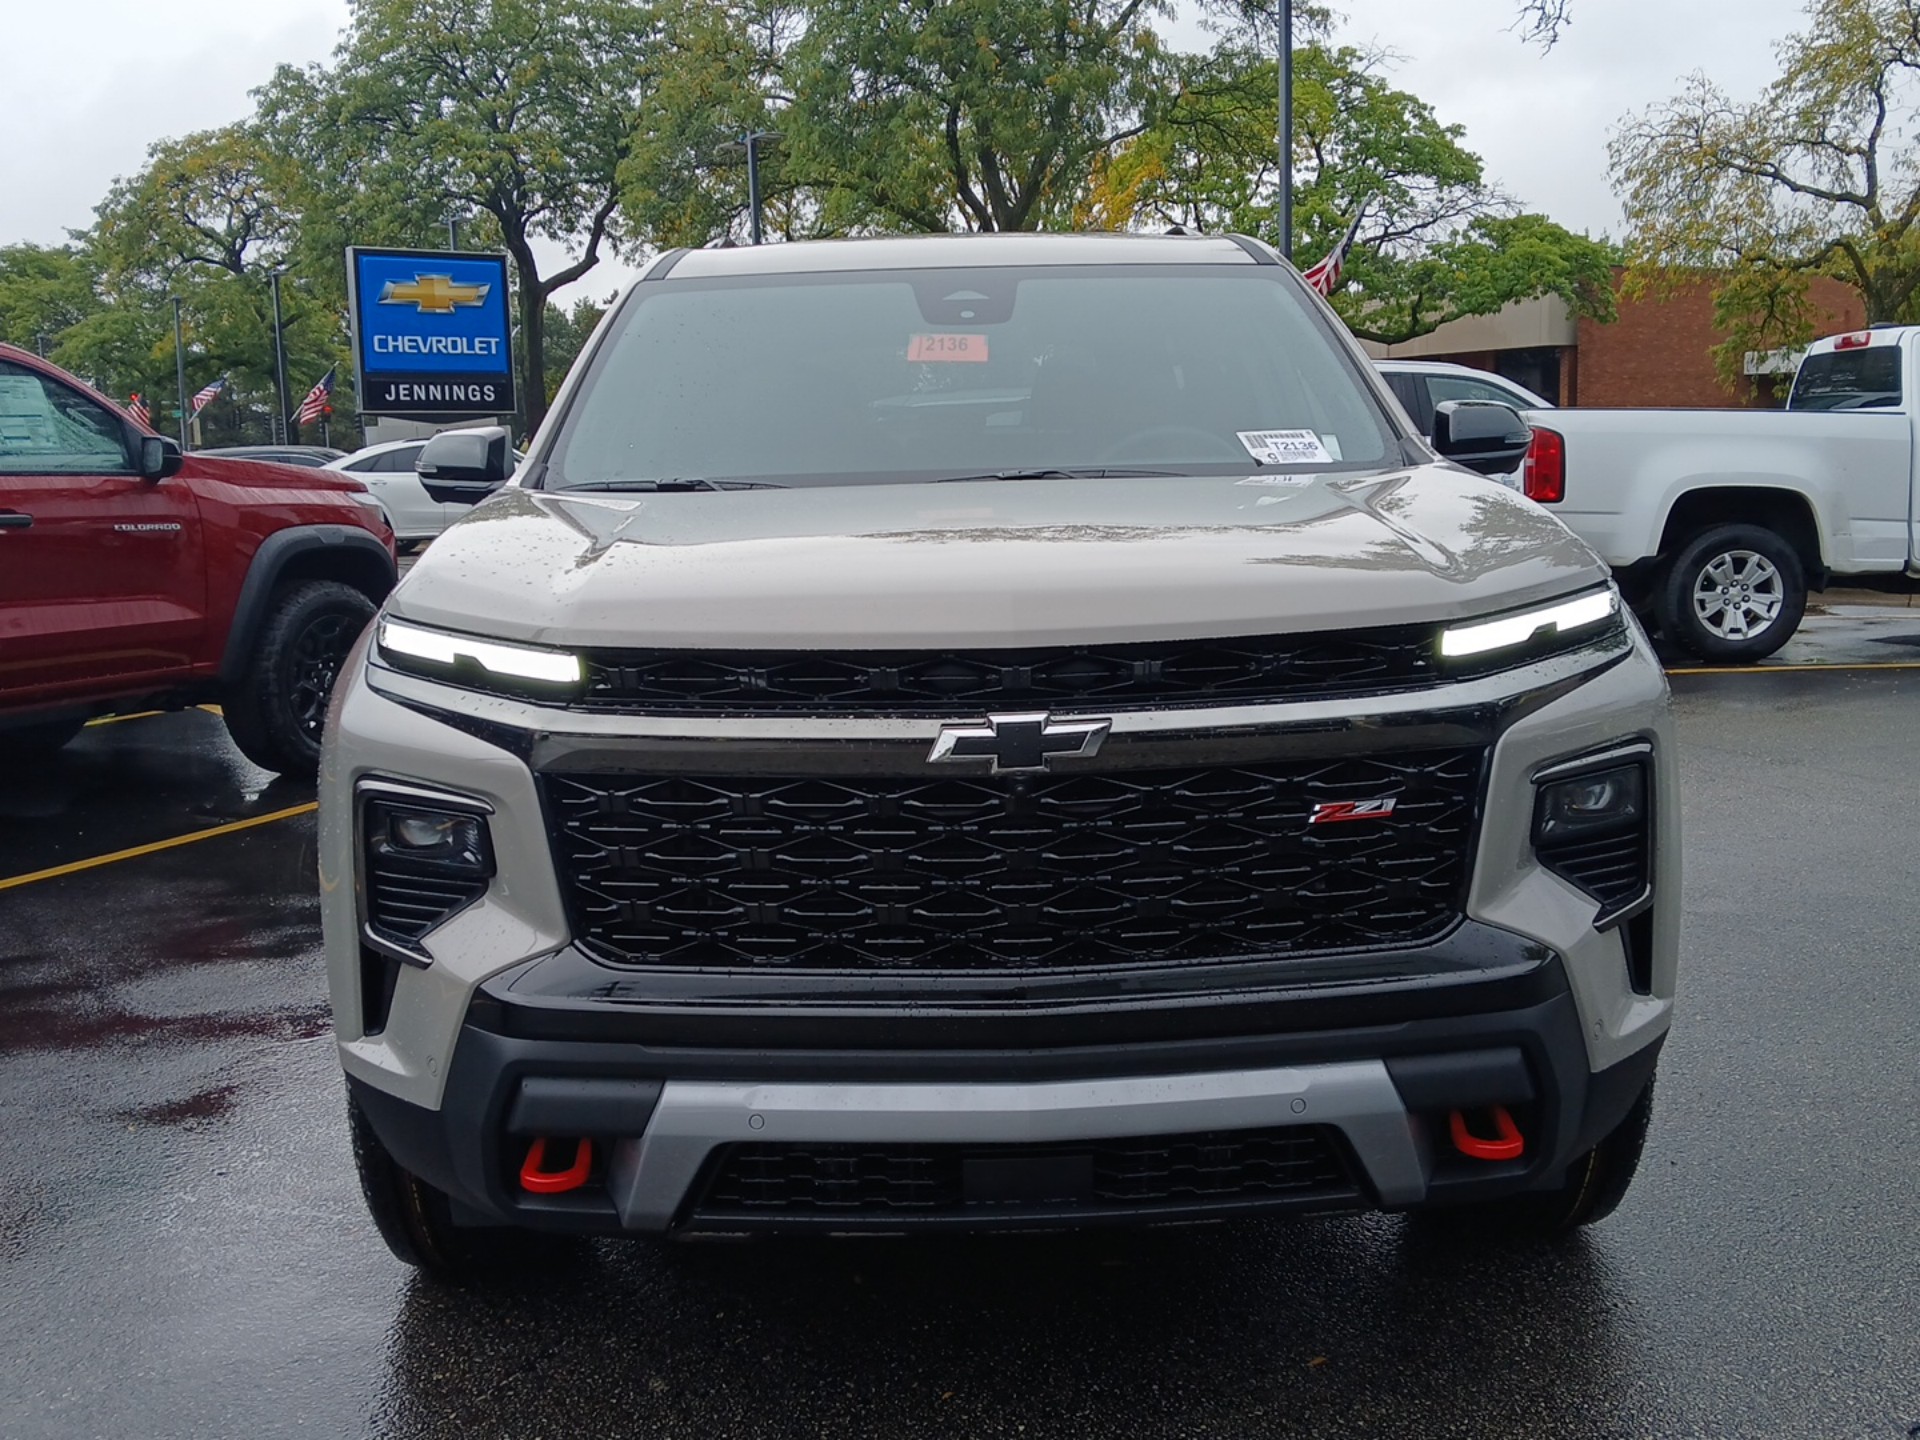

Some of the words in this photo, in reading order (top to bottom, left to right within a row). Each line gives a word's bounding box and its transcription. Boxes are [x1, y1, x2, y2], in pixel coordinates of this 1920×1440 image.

[373, 335, 500, 355] CHEVROLET
[925, 336, 968, 352] 2136
[384, 383, 496, 402] JENNINGS
[1270, 441, 1319, 451] T2136
[113, 523, 181, 532] COLORADO
